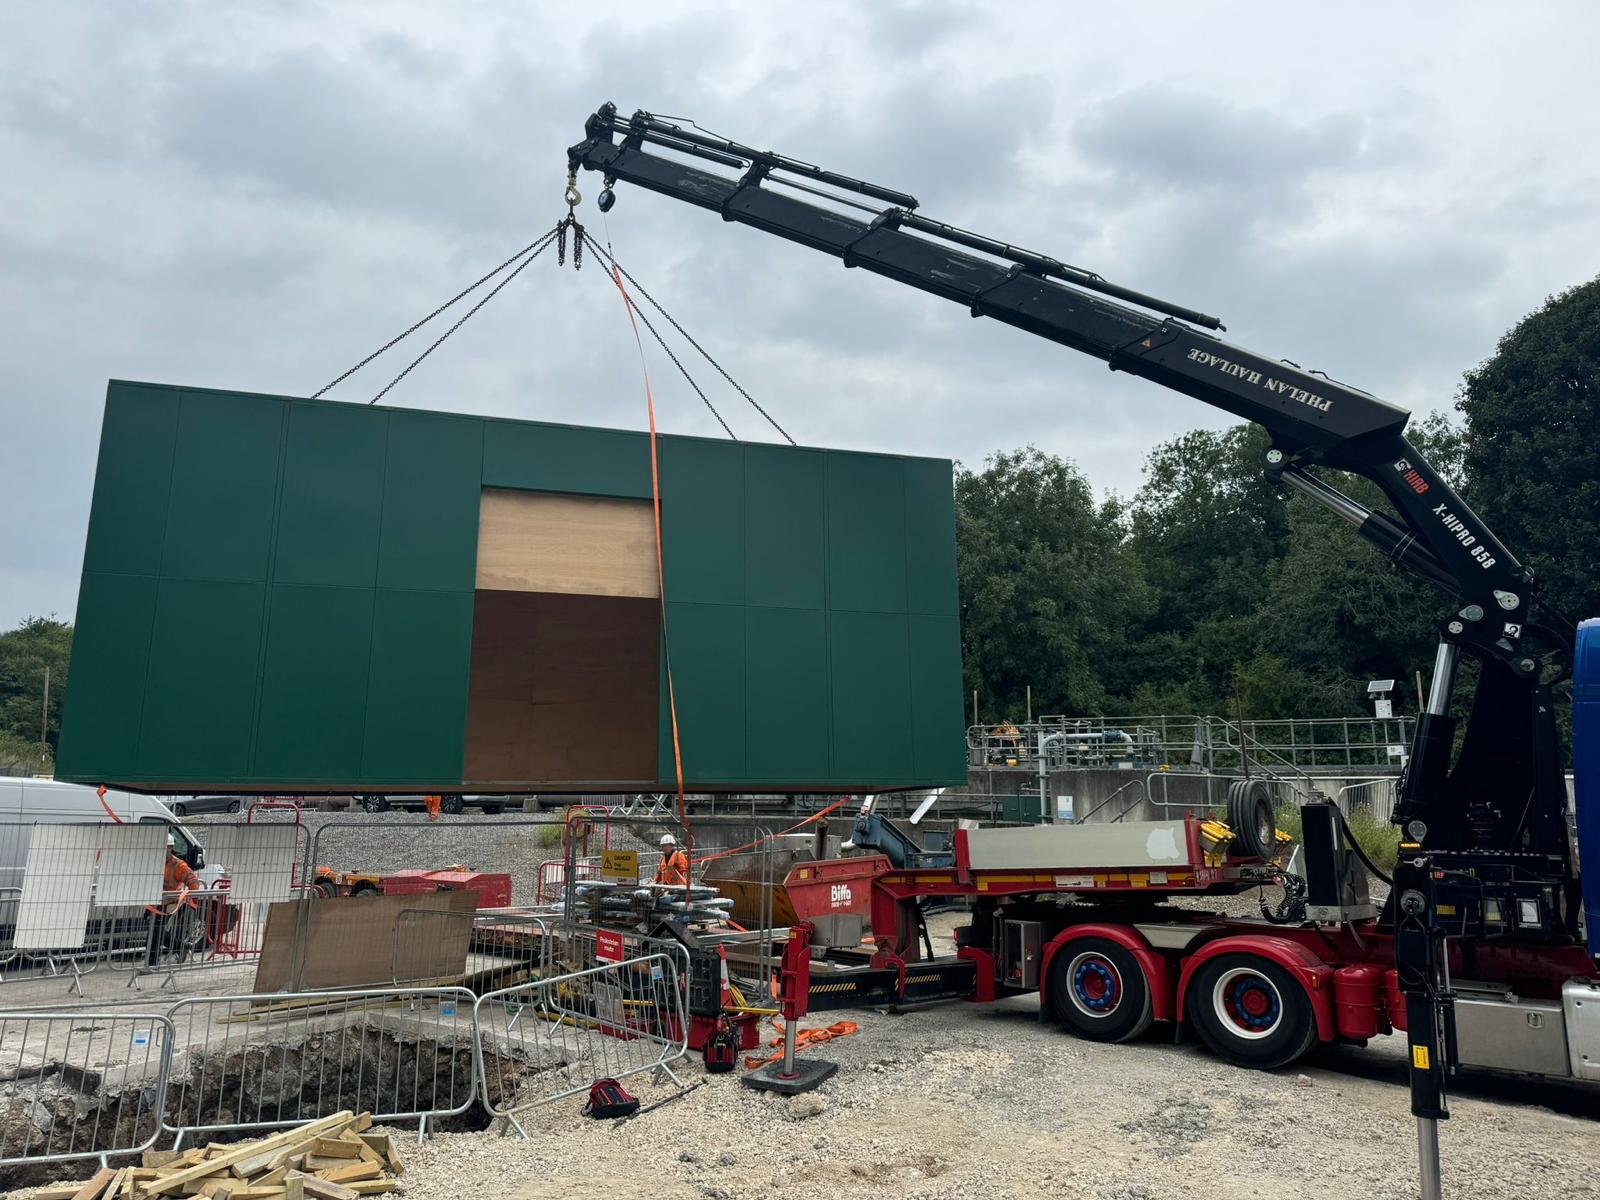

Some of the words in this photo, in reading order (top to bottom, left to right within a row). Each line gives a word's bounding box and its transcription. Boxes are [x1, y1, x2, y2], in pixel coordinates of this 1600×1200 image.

[1187, 348, 1263, 385] HAULAGE
[1264, 377, 1334, 412] PHELAN
[1403, 469, 1430, 494] HIAB
[1432, 503, 1476, 547] X-HIPRO
[1470, 545, 1496, 569] 858
[831, 884, 852, 901] Biffa
